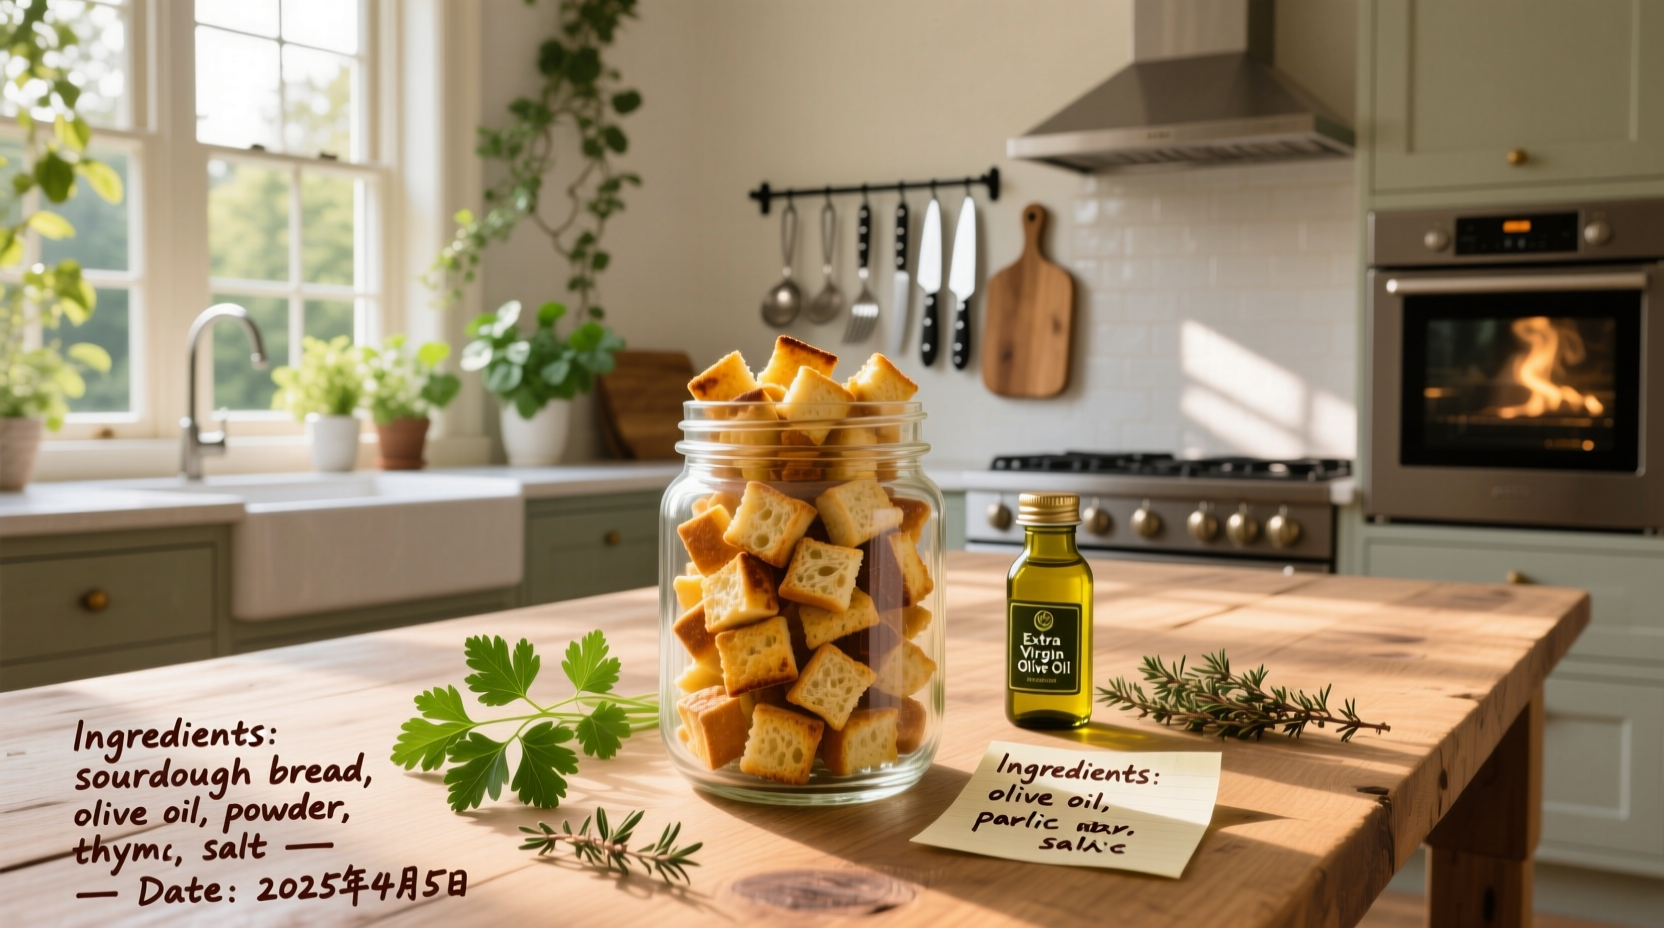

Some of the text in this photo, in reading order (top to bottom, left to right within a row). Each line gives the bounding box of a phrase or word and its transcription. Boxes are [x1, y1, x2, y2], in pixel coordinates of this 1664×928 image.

[1023, 632, 1061, 646] Extra
[1020, 645, 1064, 663] Virgin
[1017, 660, 1071, 674] Olive Oil
[996, 752, 1160, 785] Ingredients:
[988, 783, 1110, 813] olive oil,
